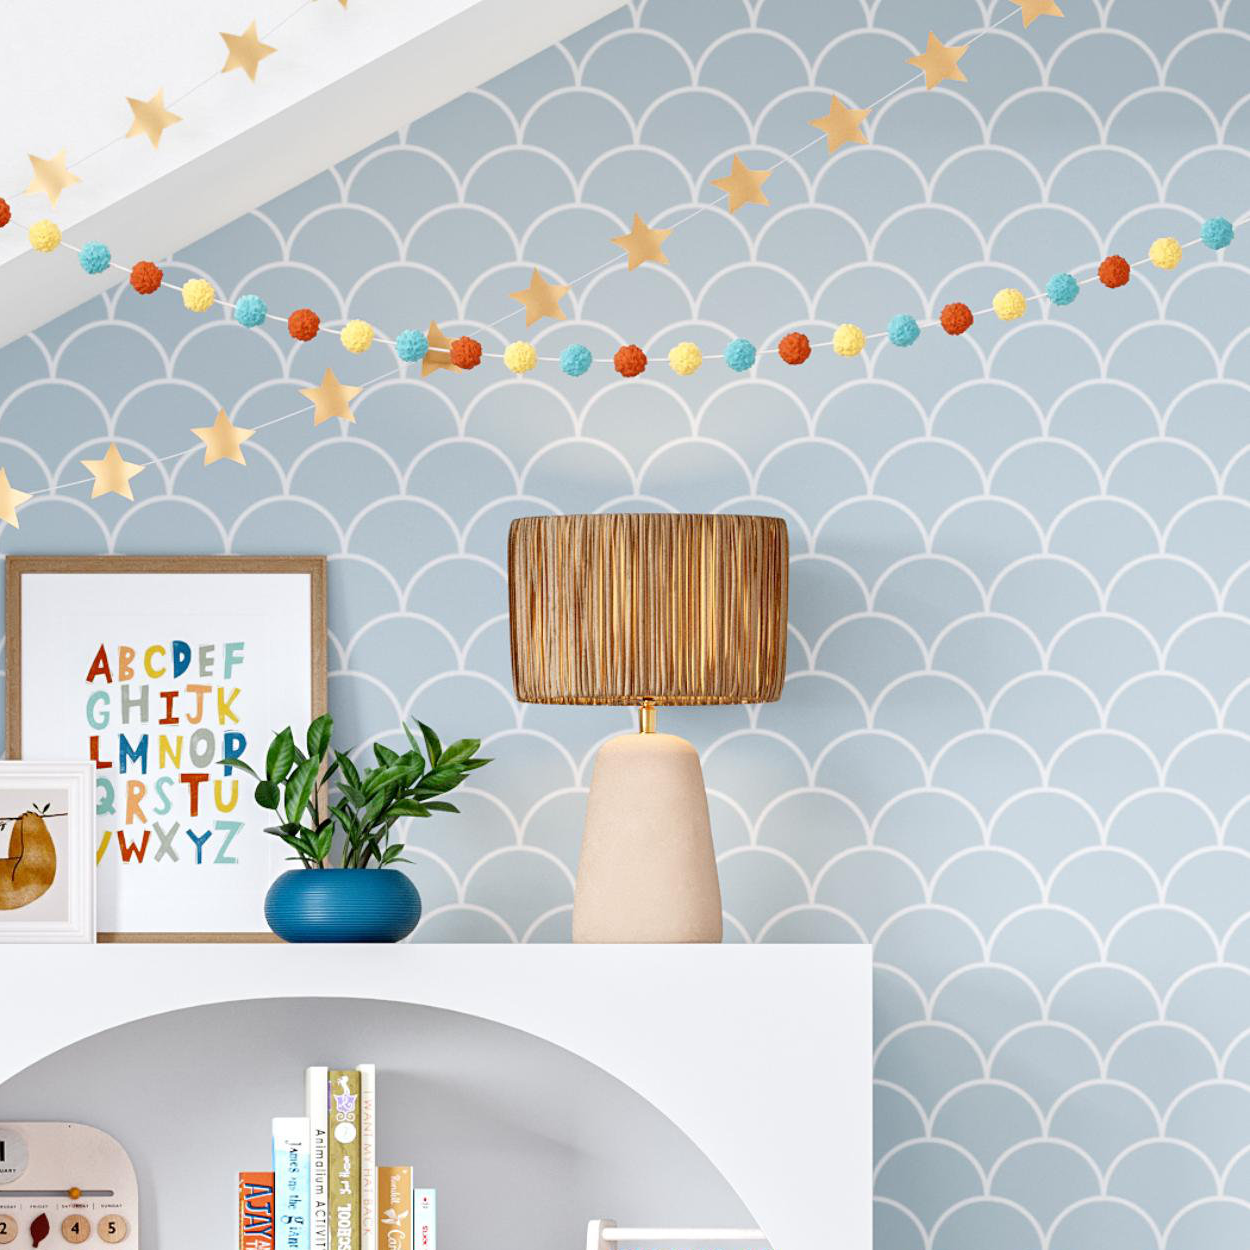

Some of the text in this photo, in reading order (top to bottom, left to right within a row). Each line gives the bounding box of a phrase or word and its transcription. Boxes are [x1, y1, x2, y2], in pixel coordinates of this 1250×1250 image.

[85, 640, 245, 685] ABCDEF
[86, 684, 242, 730] GHIJK
[363, 1098, 372, 1137] WANT
[315, 1129, 326, 1196] Animalium
[363, 1143, 372, 1163] MY
[363, 1168, 372, 1194] HAT
[0, 1222, 7, 1235] 2
[71, 1222, 80, 1234] 4
[108, 1222, 116, 1234] 5
[243, 1183, 274, 1239] AJAY
[363, 1198, 372, 1236] BACK
